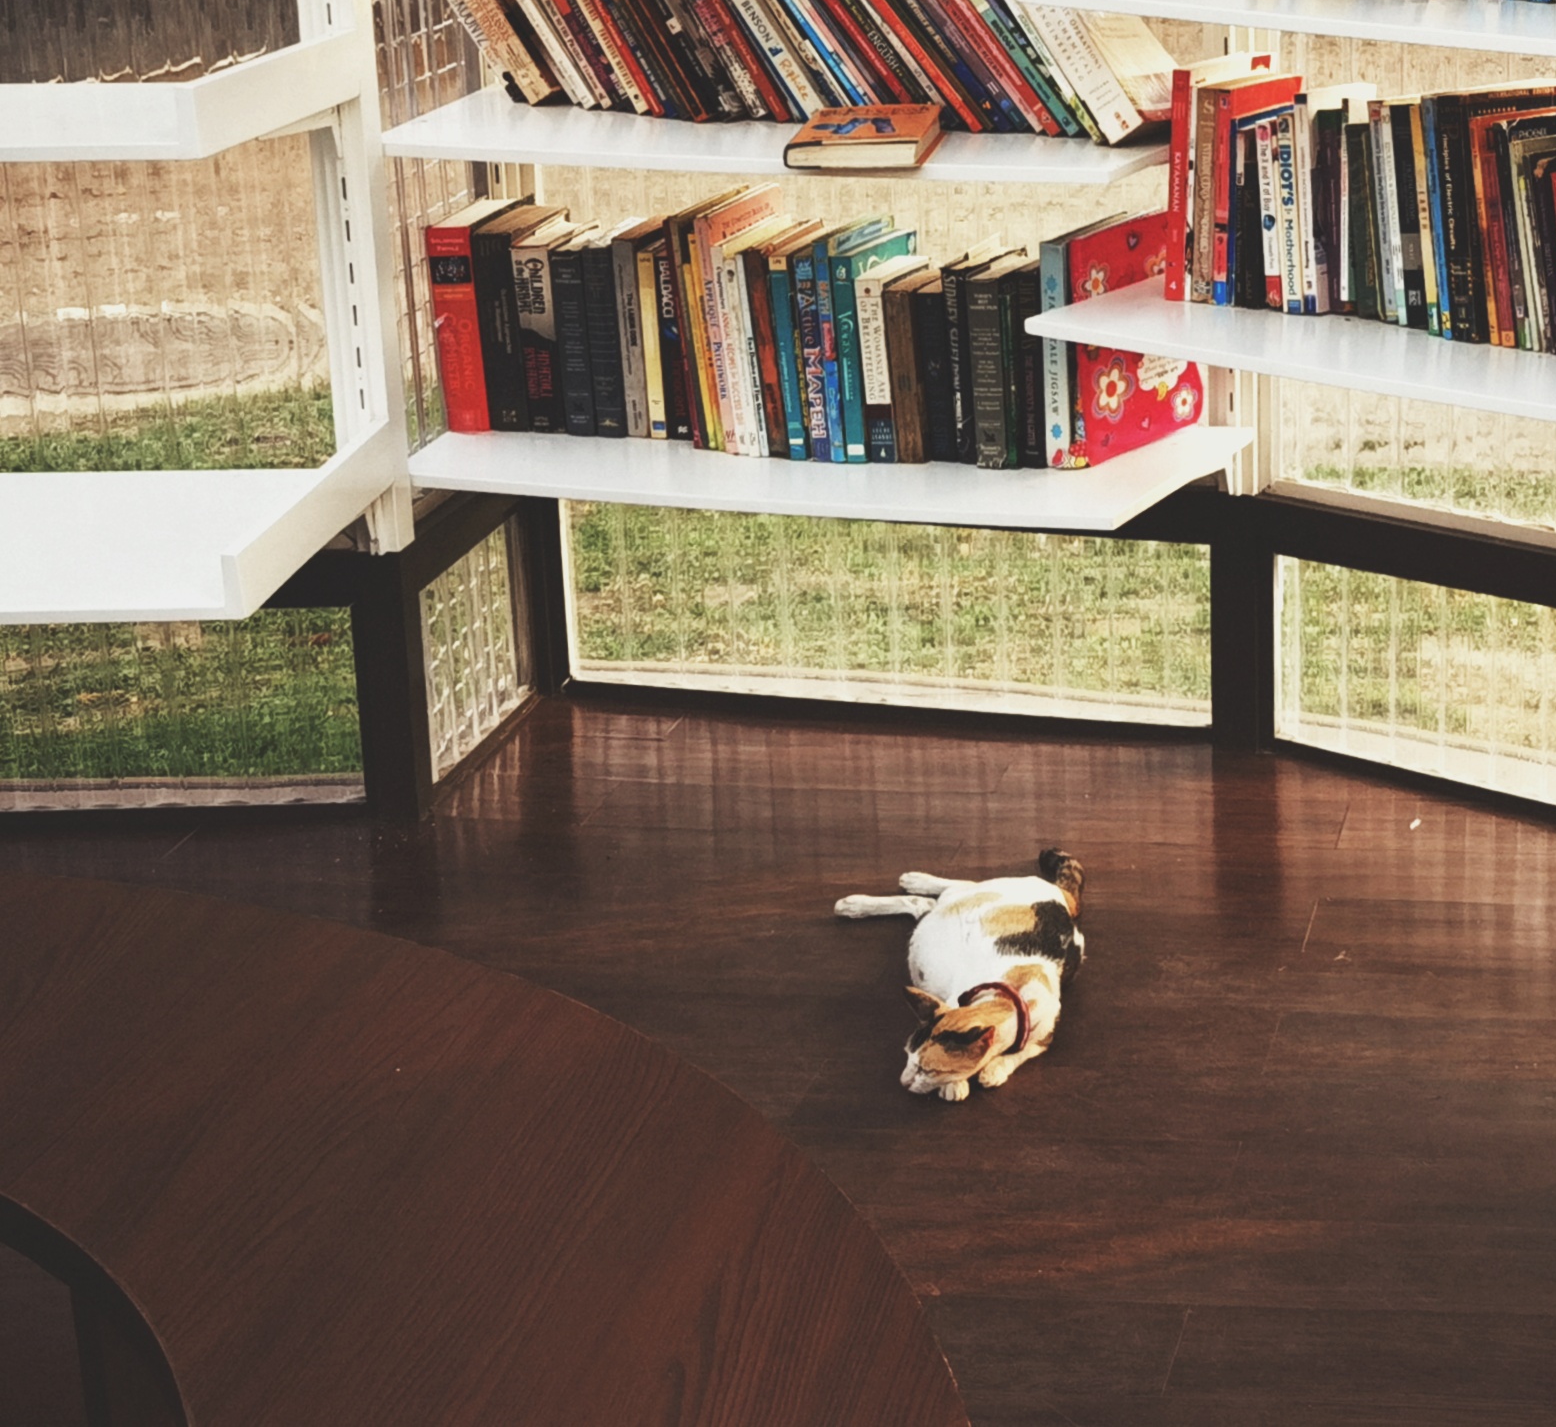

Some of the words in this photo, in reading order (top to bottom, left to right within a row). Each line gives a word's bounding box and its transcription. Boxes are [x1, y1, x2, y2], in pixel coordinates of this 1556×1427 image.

[1279, 144, 1294, 206] IDIOT'S
[658, 260, 674, 318] BALDACCI
[1284, 218, 1297, 296] Motherhood
[803, 347, 826, 439] MAPEH
